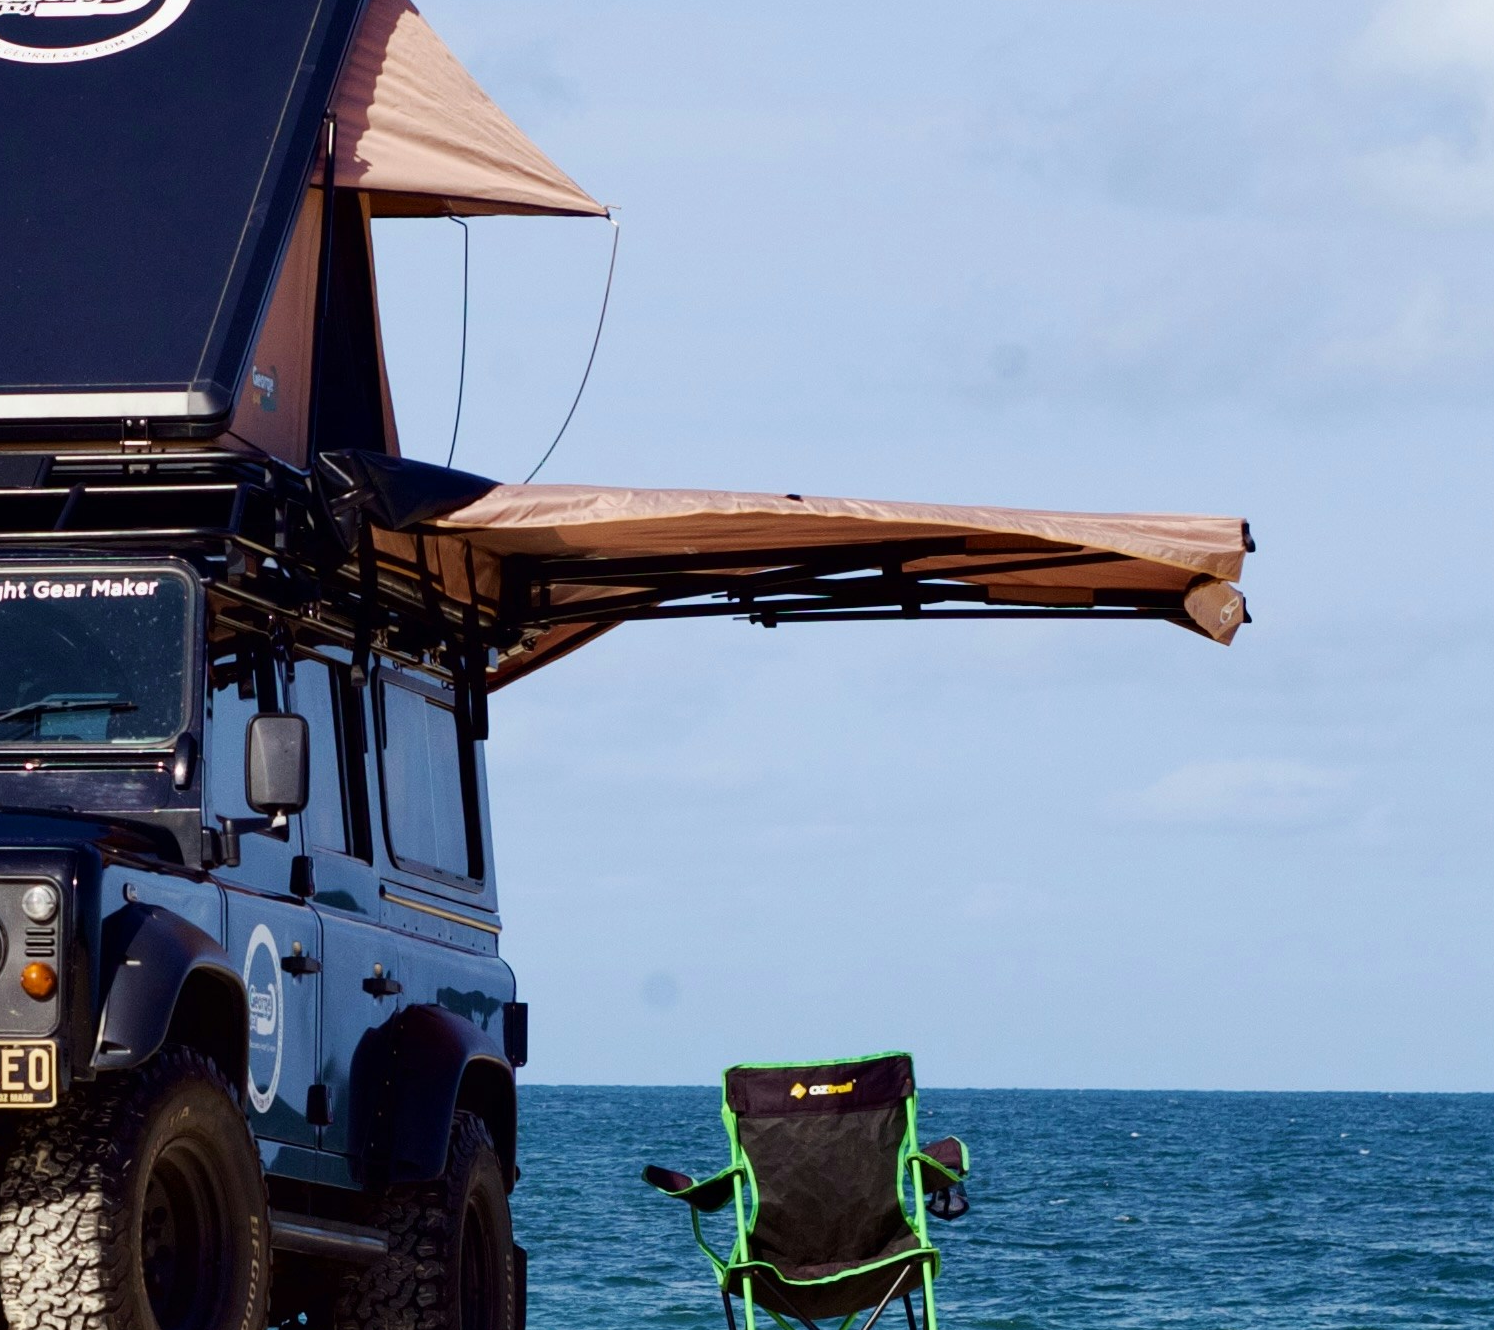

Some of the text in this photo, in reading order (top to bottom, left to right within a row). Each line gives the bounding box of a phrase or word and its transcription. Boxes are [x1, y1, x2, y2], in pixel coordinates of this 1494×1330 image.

[32, 580, 84, 599] Gear
[91, 578, 158, 597] Maker
[10, 1093, 33, 1103] MADE
